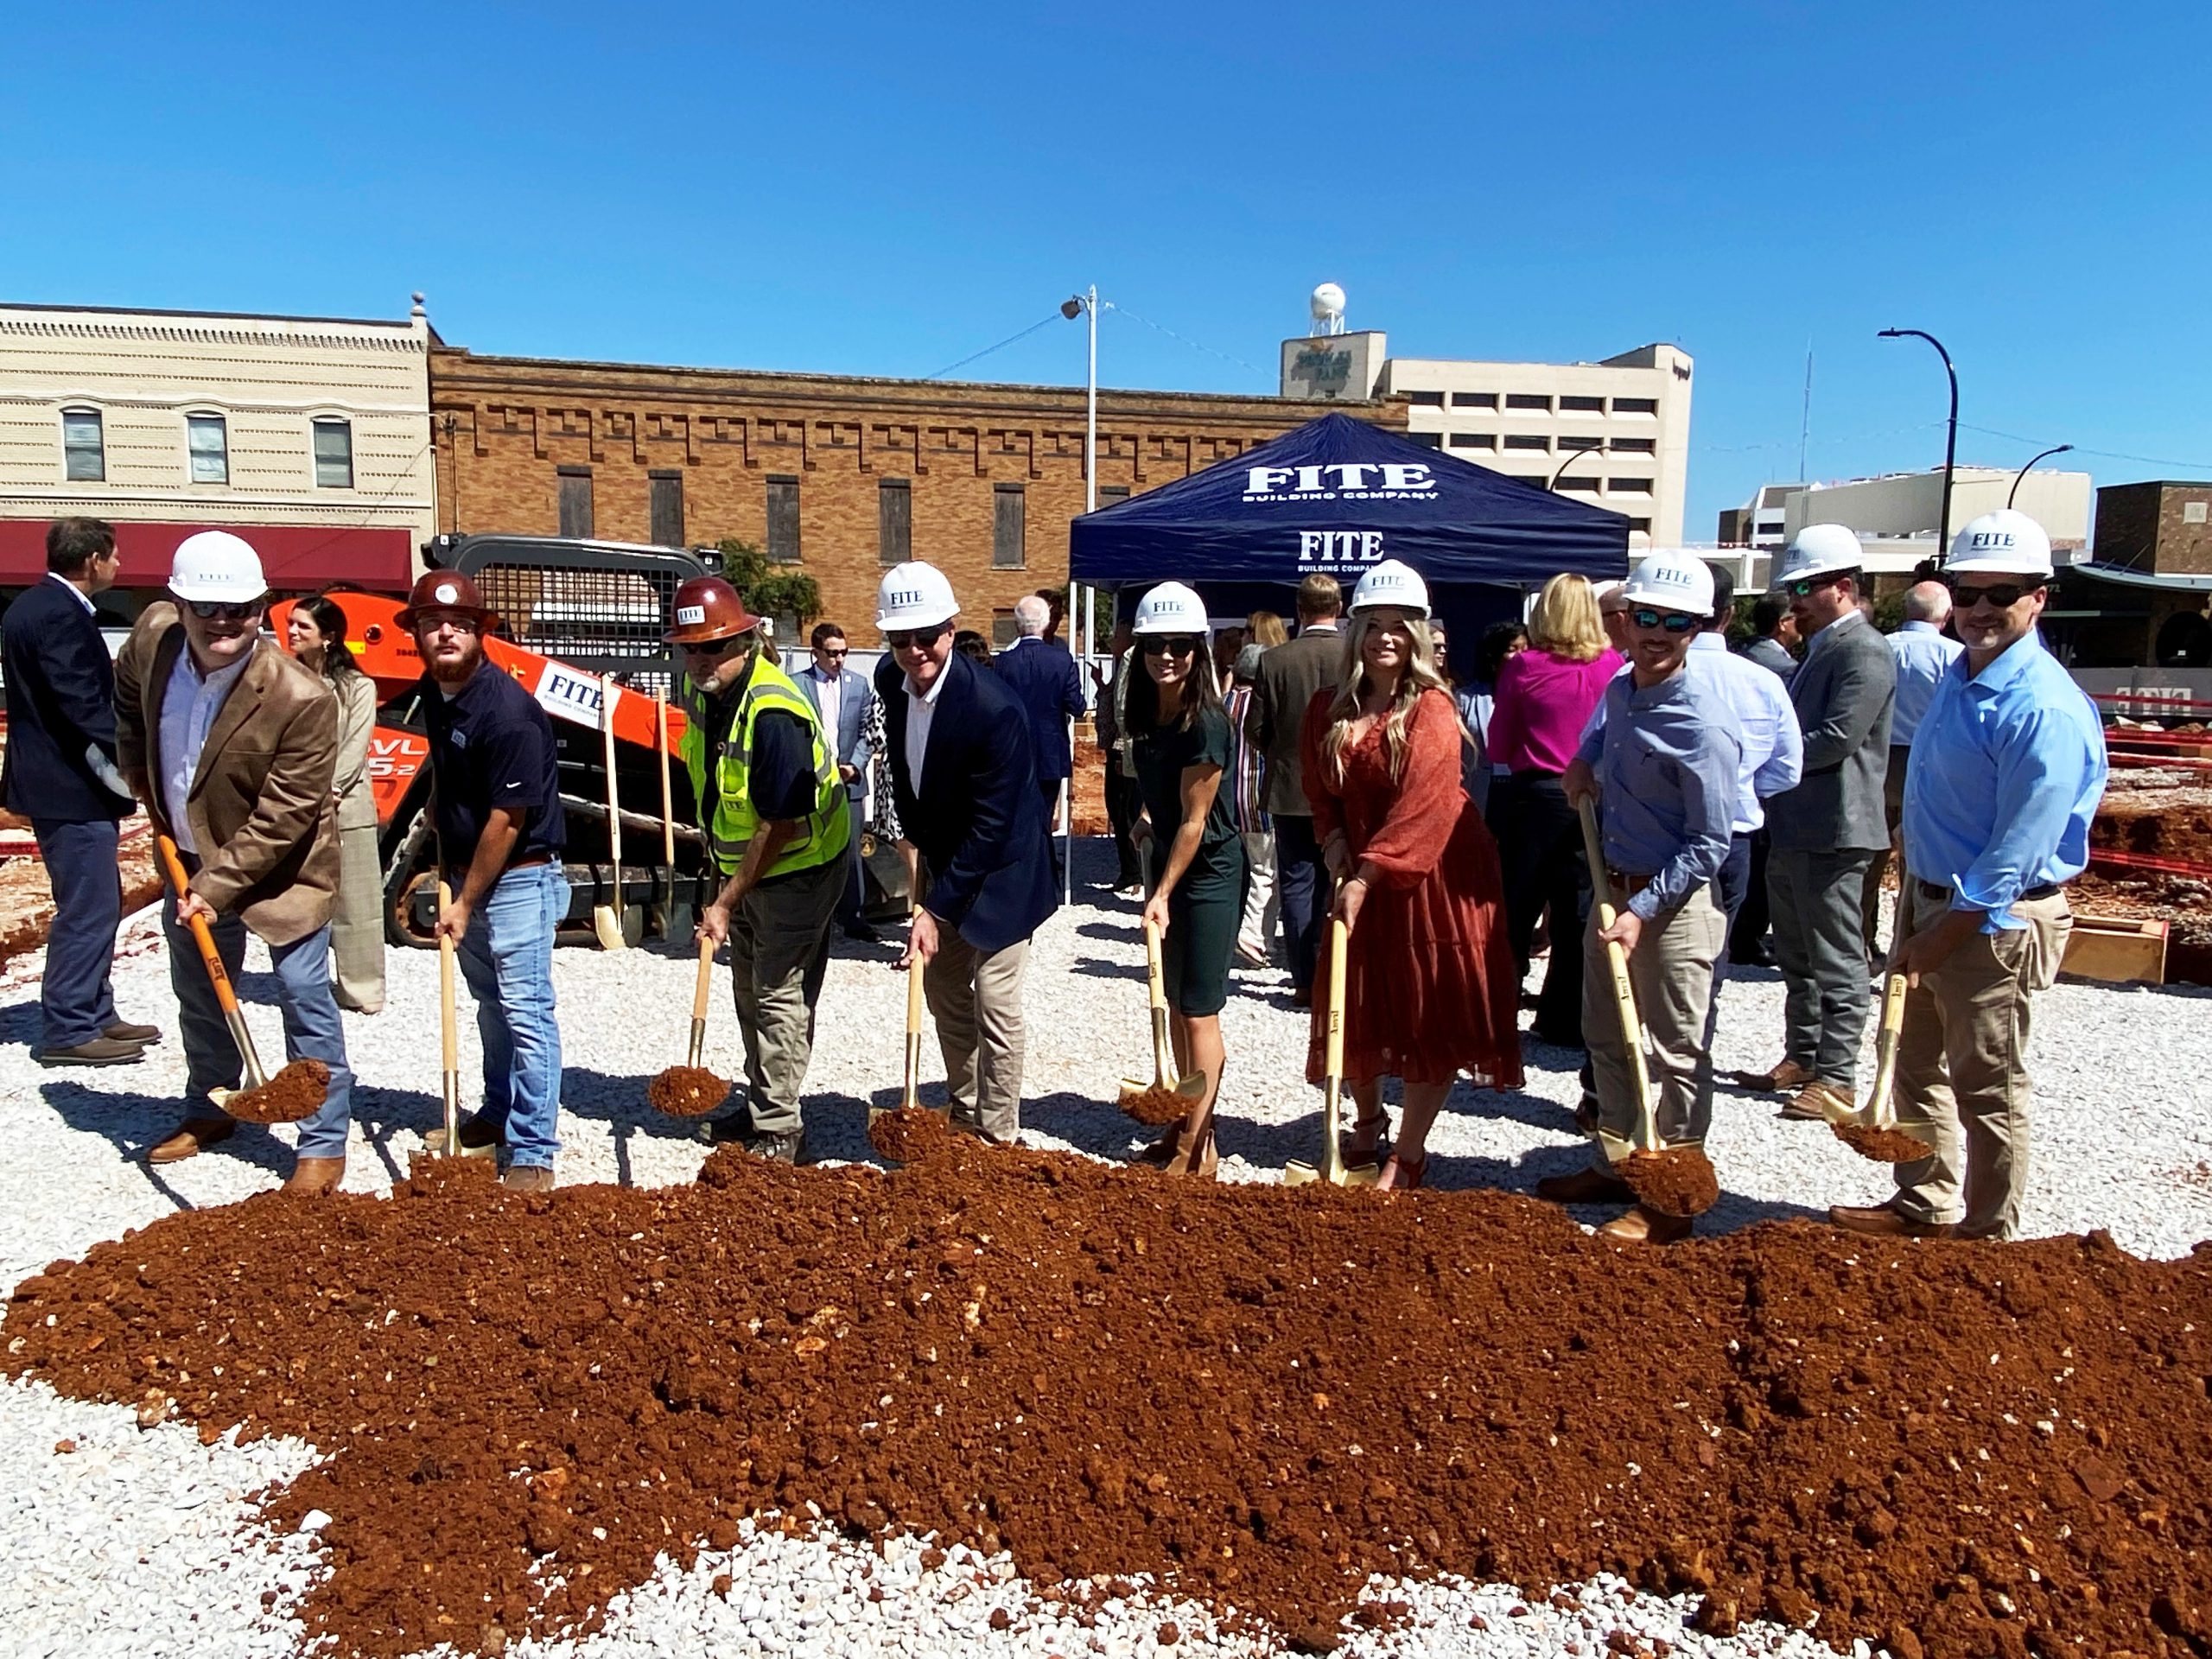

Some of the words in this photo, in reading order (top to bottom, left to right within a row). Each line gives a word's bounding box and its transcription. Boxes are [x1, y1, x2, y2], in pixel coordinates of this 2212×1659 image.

[1243, 464, 1436, 493] FITE
[1243, 493, 1336, 502] BUILDING
[1299, 531, 1384, 561] FITE
[1972, 533, 2015, 546] FITE
[1372, 575, 1405, 587] FITE
[1655, 568, 1693, 585] FITE
[891, 590, 924, 605] FITE
[1154, 601, 1185, 612] FITE
[548, 674, 604, 711] FITE
[368, 739, 426, 755] VL
[368, 757, 416, 776] 5-2
[1616, 976, 1630, 1001] Anvil
